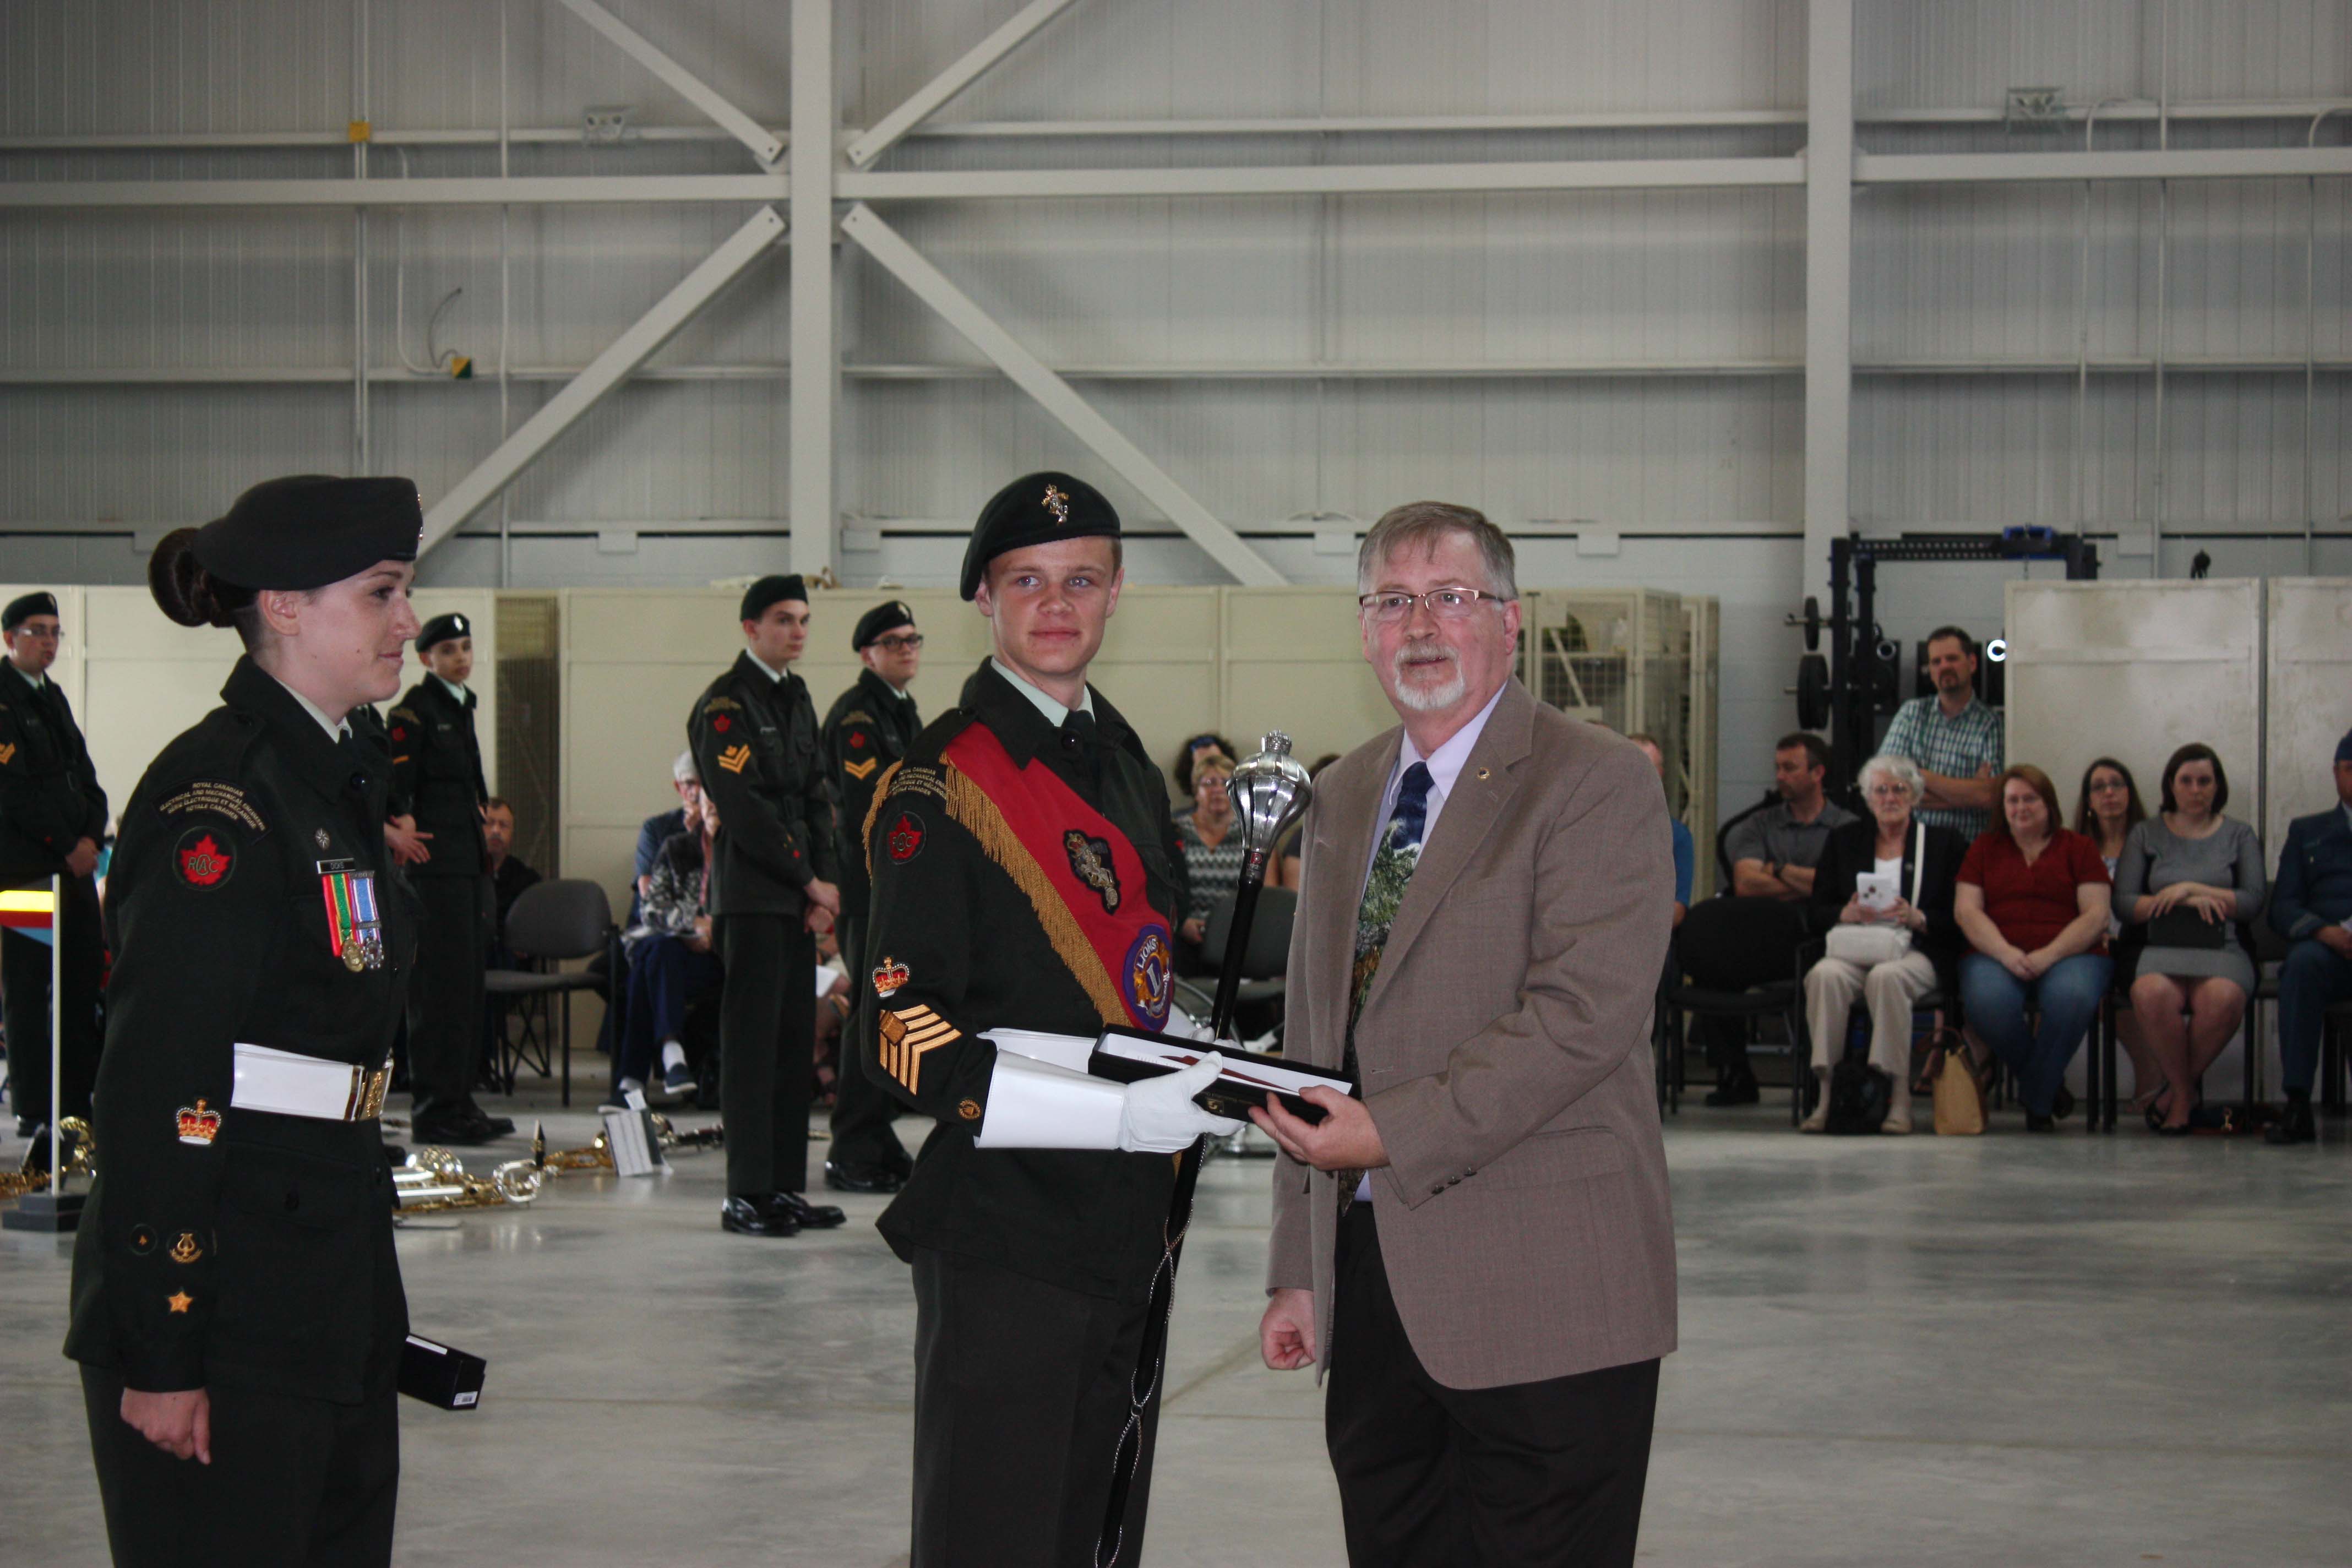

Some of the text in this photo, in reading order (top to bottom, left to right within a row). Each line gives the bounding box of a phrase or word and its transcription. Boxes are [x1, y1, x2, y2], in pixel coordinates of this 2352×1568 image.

[205, 790, 243, 804] MECHANICAL
[213, 783, 244, 797] CANADIAN
[210, 804, 239, 820] CANADIEN
[1137, 938, 1157, 968] LIONS
